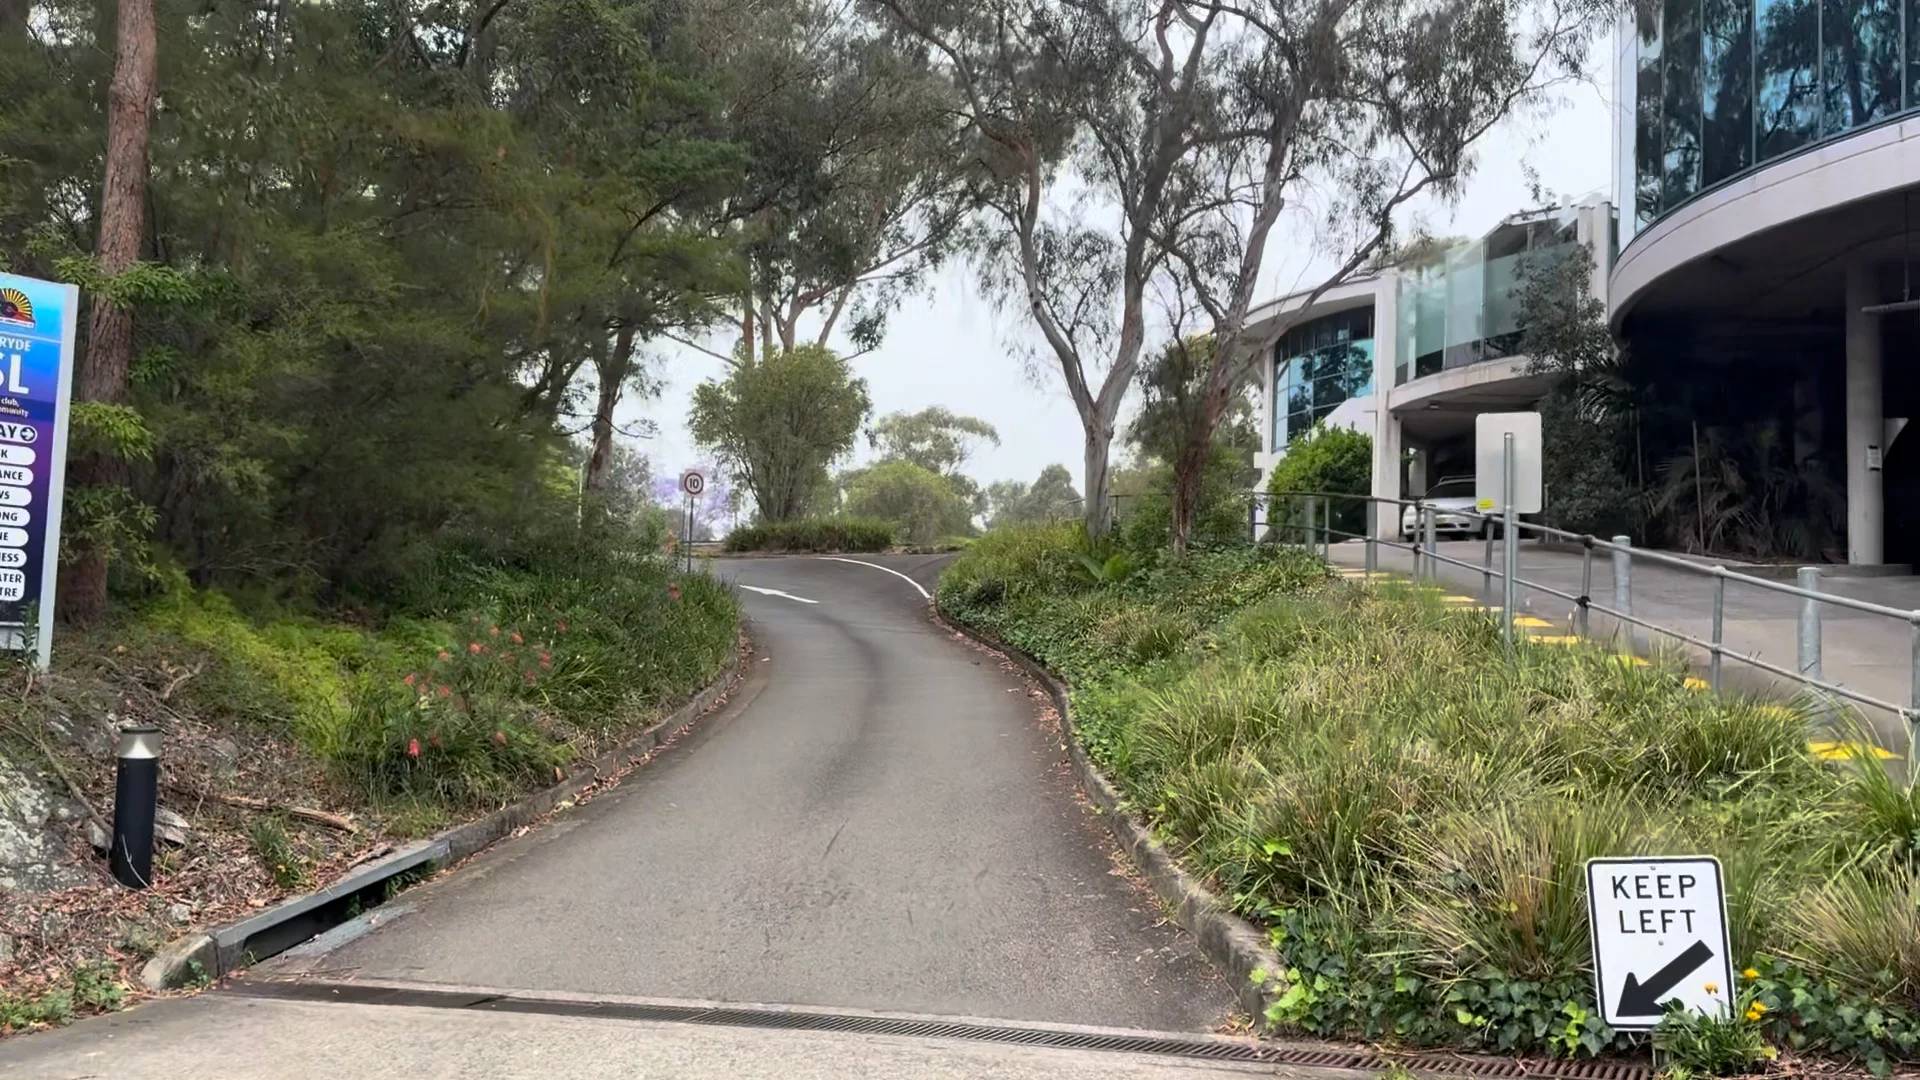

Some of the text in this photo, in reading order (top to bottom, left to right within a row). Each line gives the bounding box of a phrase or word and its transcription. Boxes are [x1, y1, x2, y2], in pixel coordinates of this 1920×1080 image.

[689, 477, 700, 489] 10
[1611, 874, 1697, 899] KEEP
[1619, 909, 1696, 934] LEFT
